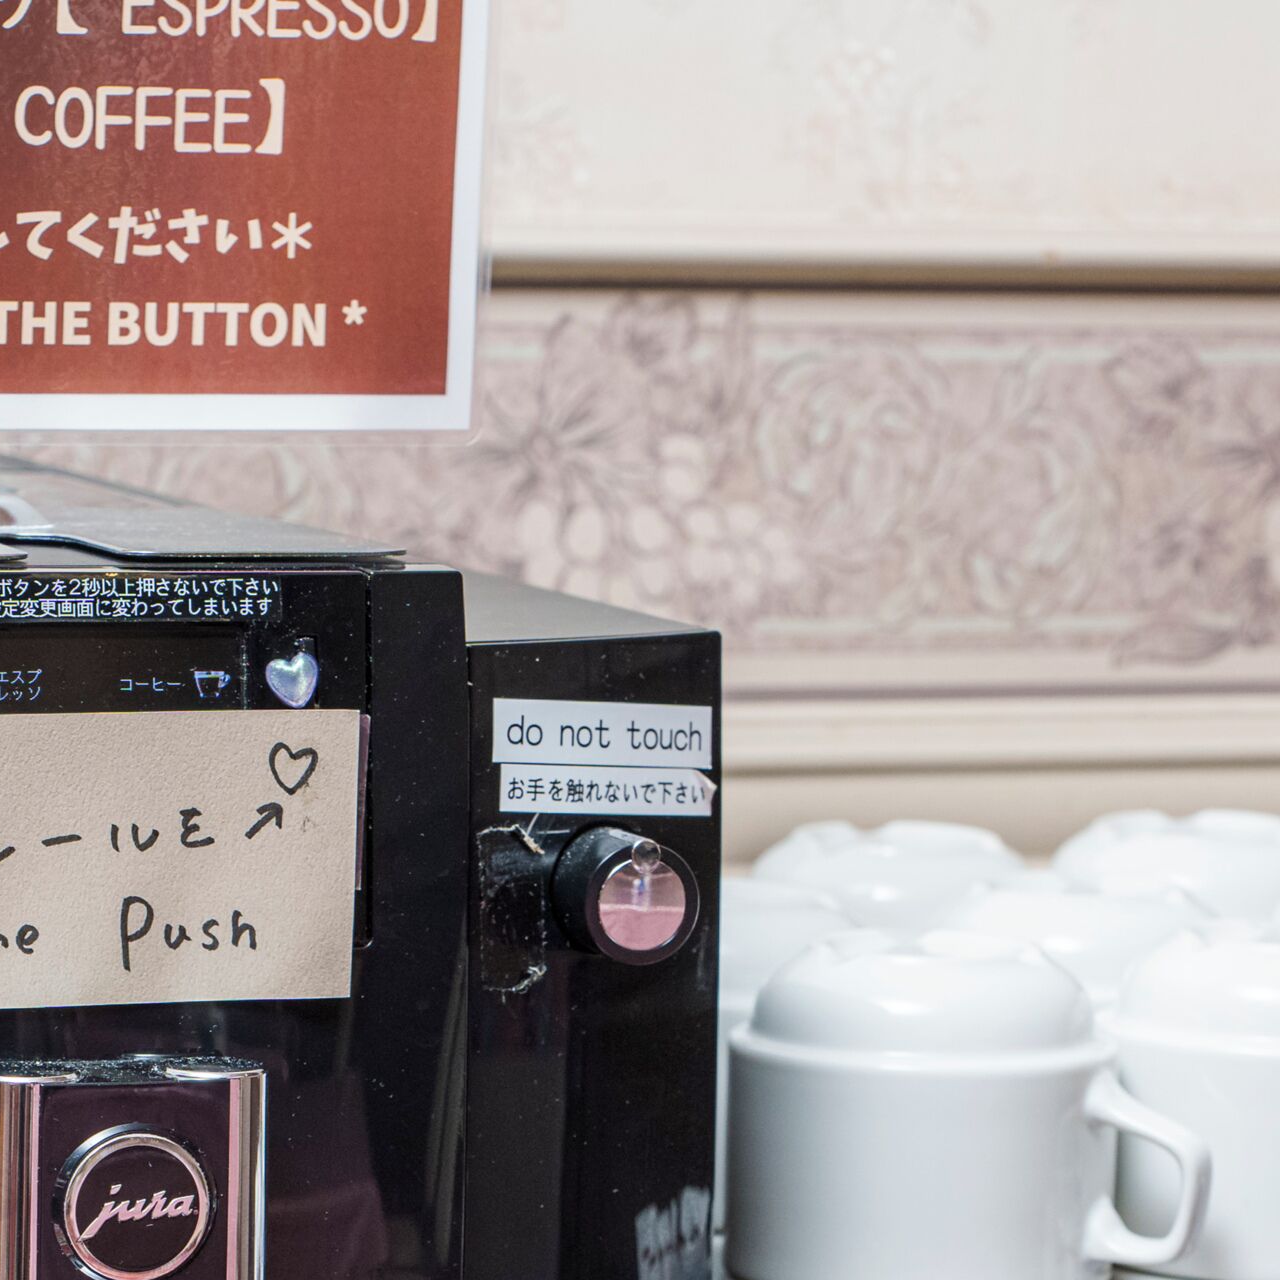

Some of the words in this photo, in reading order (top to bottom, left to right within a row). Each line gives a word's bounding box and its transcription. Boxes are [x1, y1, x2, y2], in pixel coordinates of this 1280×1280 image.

[108, 301, 327, 348] BUTTON
[119, 678, 182, 692] コーヒー
[506, 715, 543, 747] do
[559, 719, 611, 749] not
[627, 720, 702, 752] touch
[507, 776, 706, 805] お手を触れないで下さい
[120, 895, 258, 972] Push
[76, 1184, 195, 1243] jura
